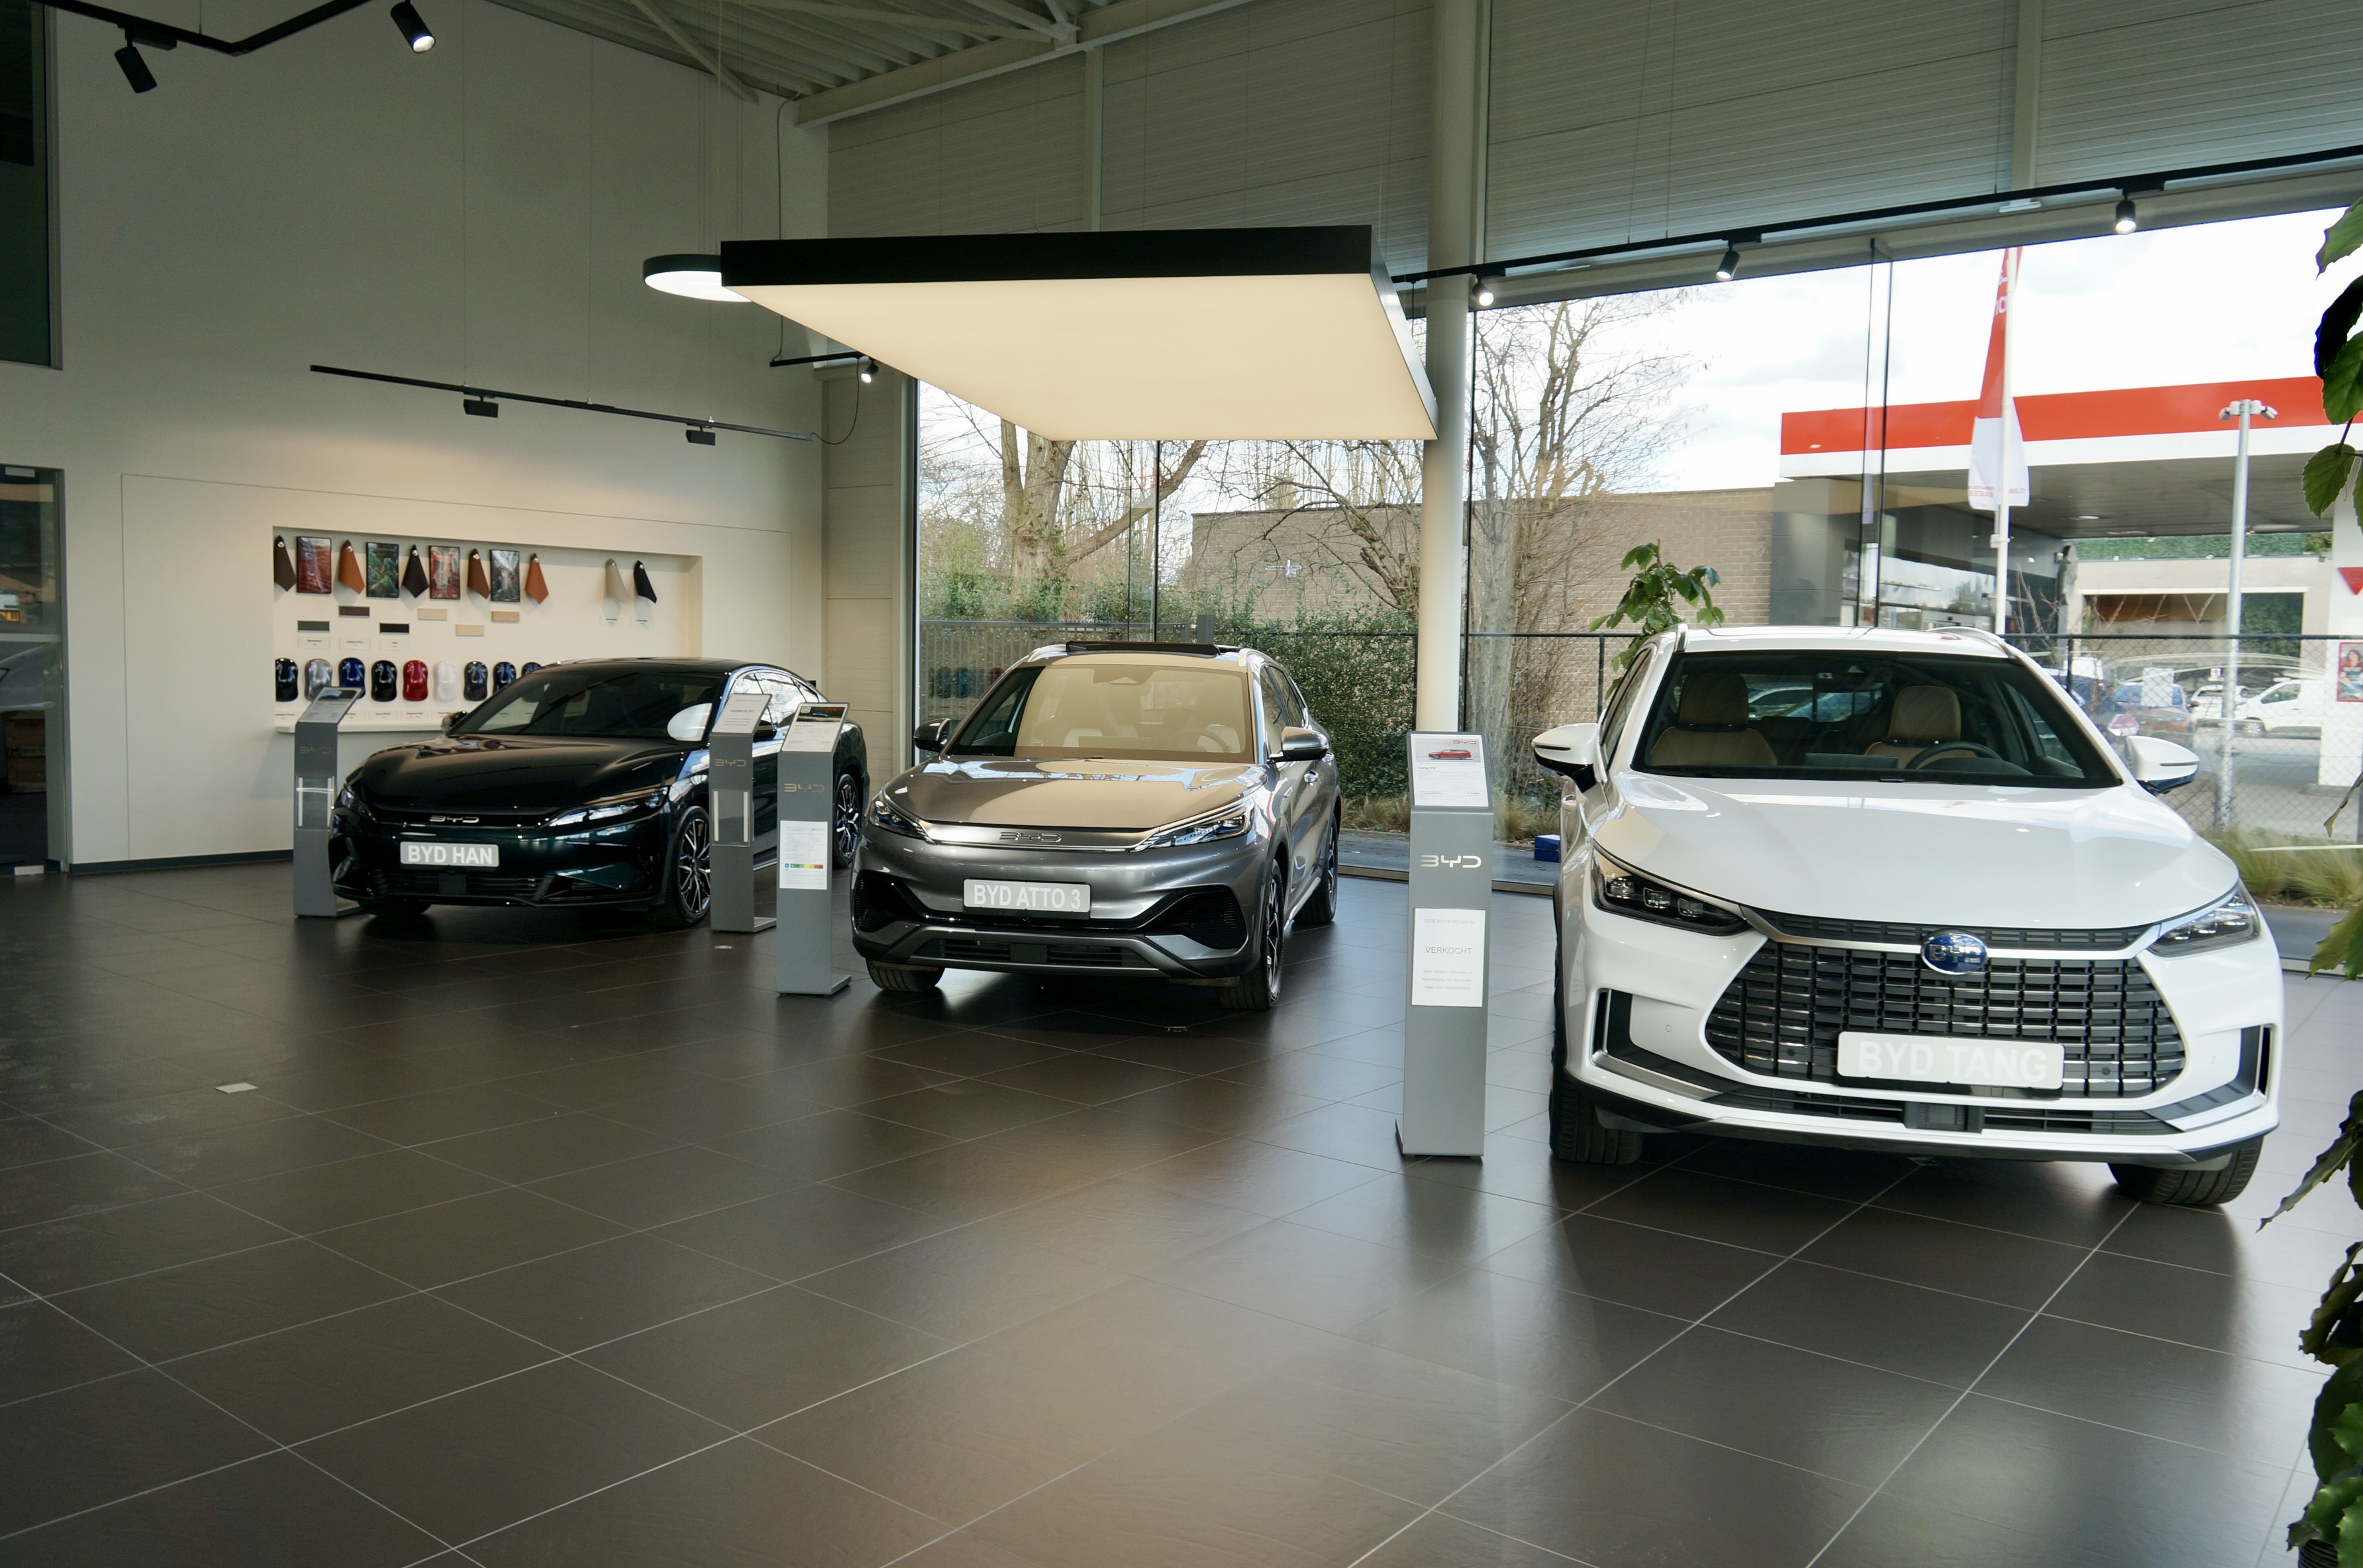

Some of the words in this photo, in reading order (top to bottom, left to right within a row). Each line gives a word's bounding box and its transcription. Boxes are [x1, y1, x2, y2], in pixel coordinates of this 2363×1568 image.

[715, 758, 747, 767] BYD
[783, 783, 826, 793] BYD
[999, 831, 1062, 843] BYD
[408, 845, 447, 863] BYD
[452, 846, 492, 865] HAN
[1421, 854, 1482, 869] BYD
[974, 884, 1012, 906] BYD
[1016, 886, 1066, 908] ATTO
[1070, 889, 1081, 910] 3
[1425, 946, 1472, 955] VERKOCHT
[1929, 944, 1982, 964] BYD
[1858, 1040, 1935, 1076] BYD
[1945, 1045, 2048, 1083] TANG
